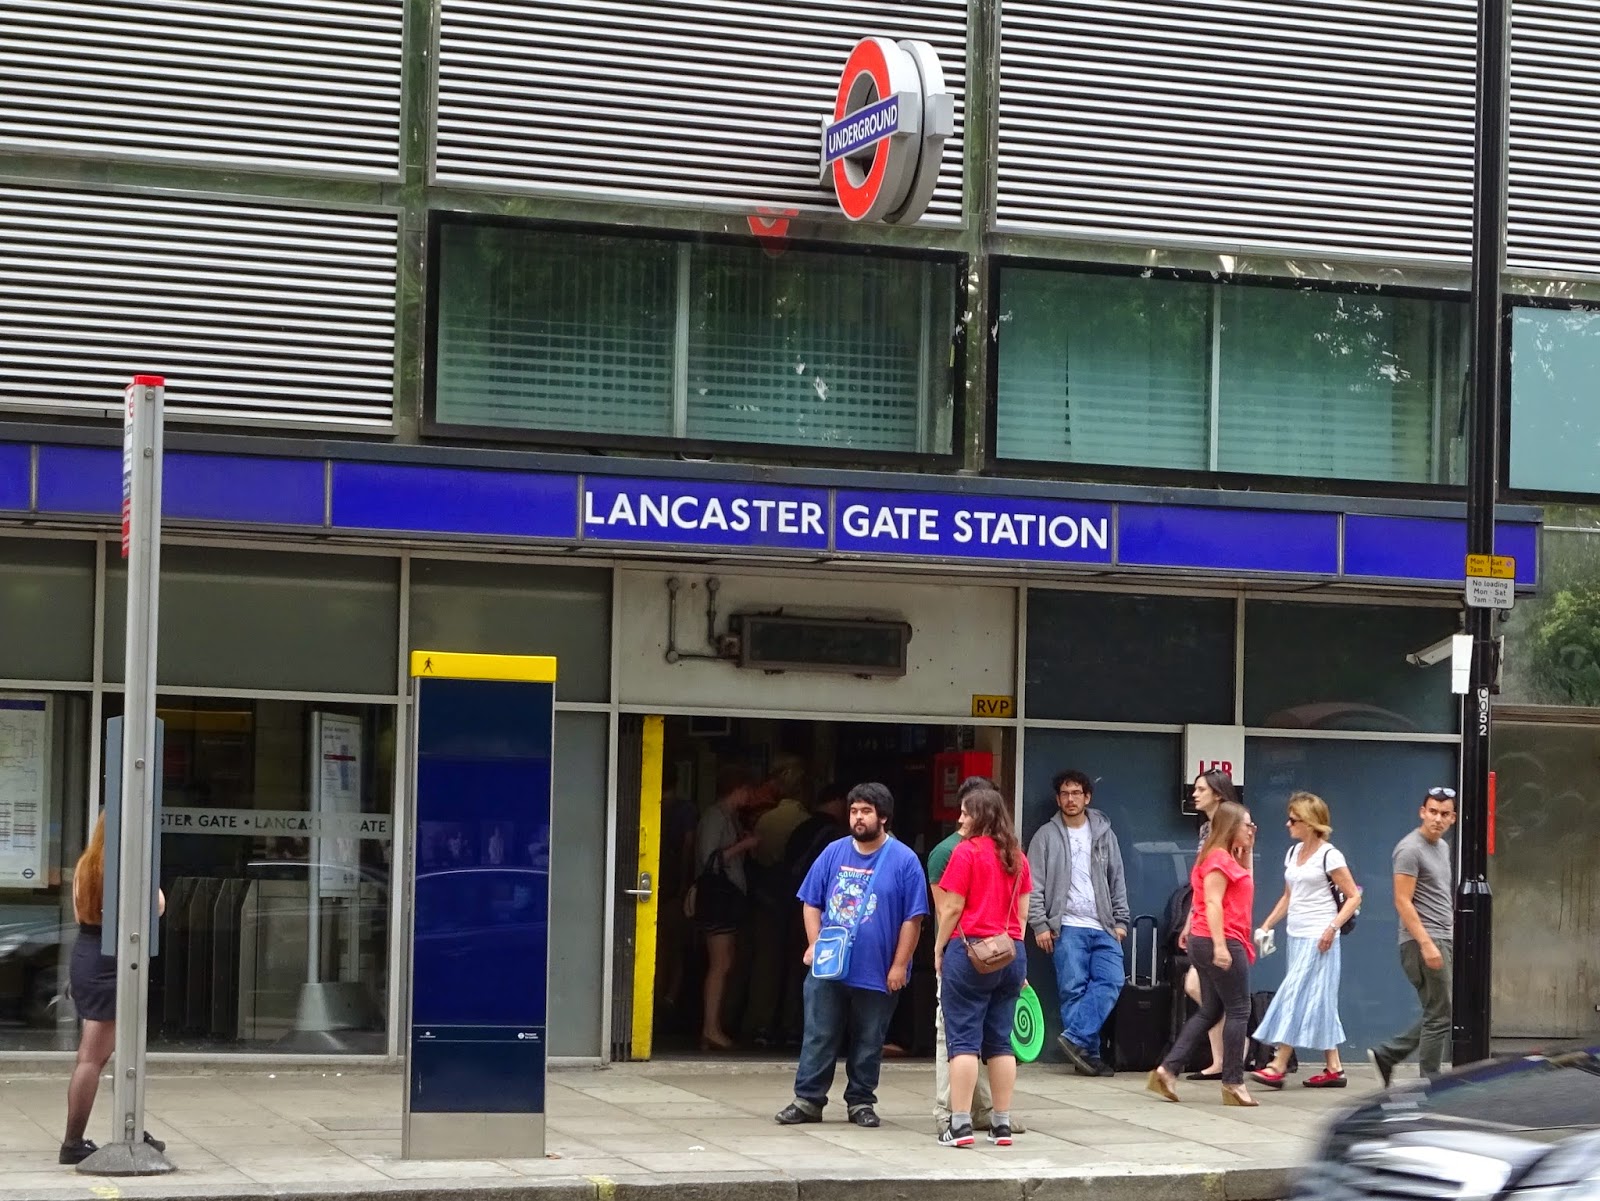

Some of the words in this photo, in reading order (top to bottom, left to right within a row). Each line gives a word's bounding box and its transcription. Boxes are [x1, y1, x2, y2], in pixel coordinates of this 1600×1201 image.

[829, 104, 898, 154] UNDERGROUND
[585, 491, 825, 535] LANCASTER
[842, 504, 940, 541] GATE
[953, 510, 1108, 549] STATION
[1470, 557, 1485, 565] Mon
[976, 699, 1009, 714] RVP
[198, 814, 237, 828] GATE
